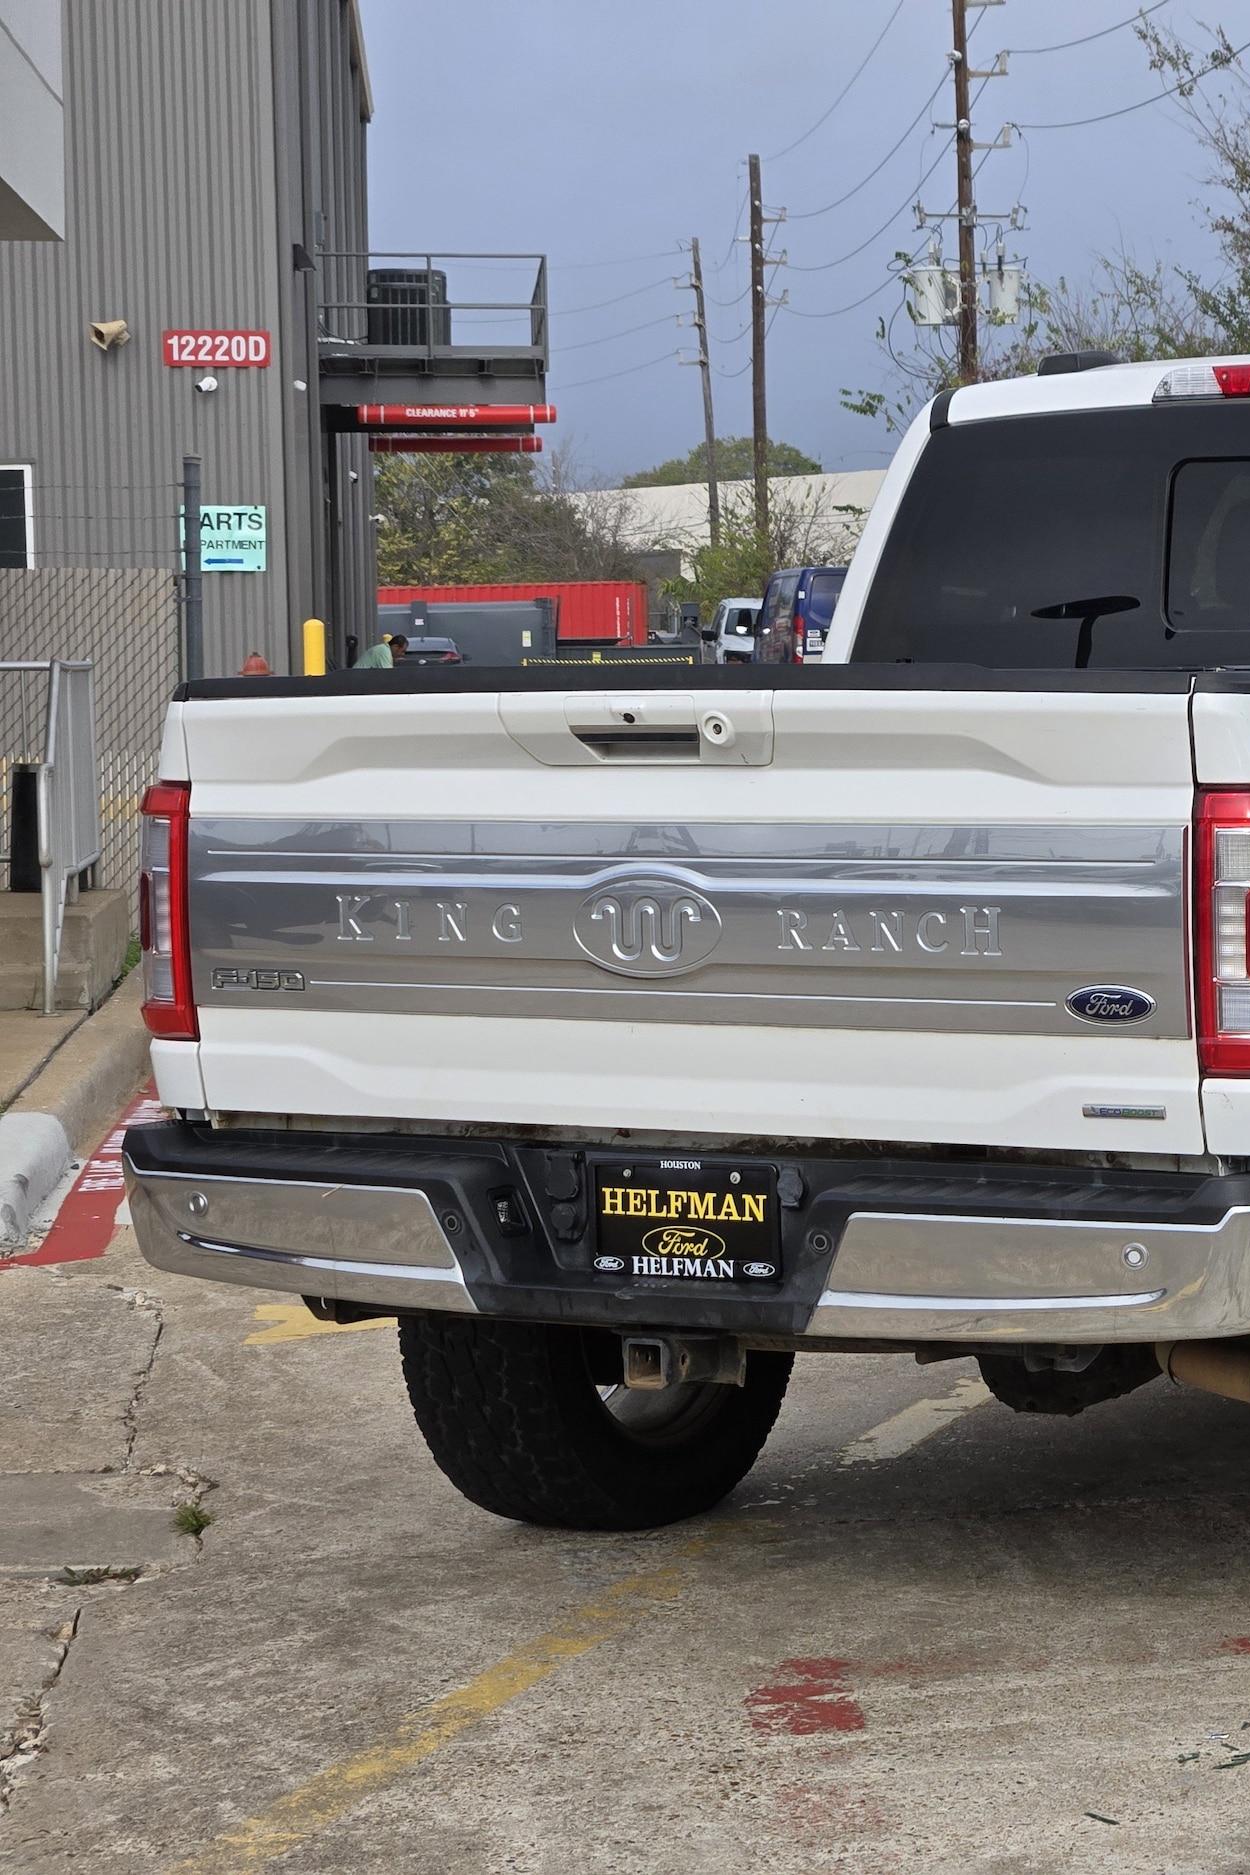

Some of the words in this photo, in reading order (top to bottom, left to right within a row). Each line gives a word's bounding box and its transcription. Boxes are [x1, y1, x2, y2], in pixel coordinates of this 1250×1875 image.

[167, 335, 266, 362] 12220D
[405, 408, 457, 418] CLEARANCE
[200, 512, 263, 531] ARTS
[200, 540, 266, 550] PARTMENT
[336, 895, 523, 942] KING
[776, 905, 1002, 956] RANCH
[211, 967, 305, 992] F-150
[1085, 993, 1134, 1016] Ford
[660, 1160, 701, 1170] HOUSTON
[602, 1187, 768, 1223] HELFMAN
[658, 1229, 709, 1257] Ford
[632, 1256, 734, 1279] HELFMAN
